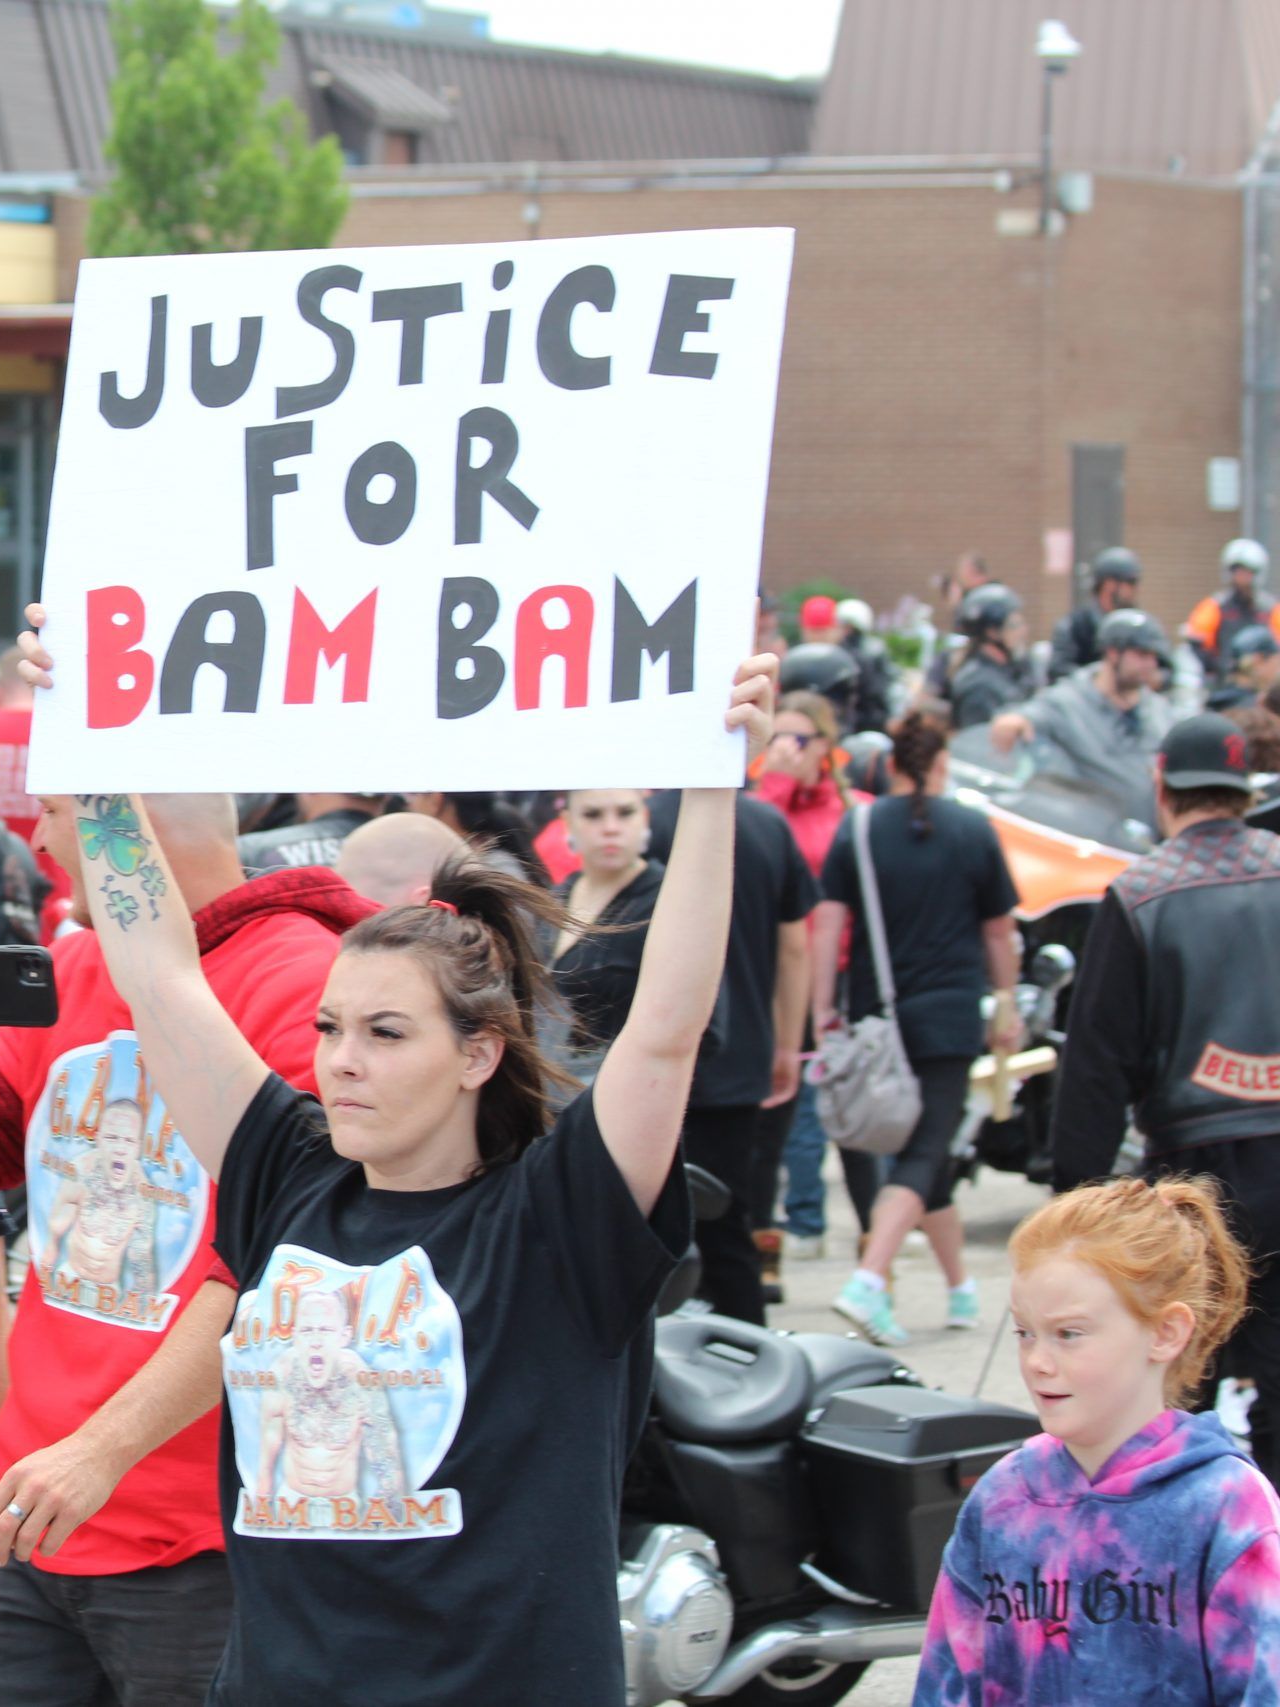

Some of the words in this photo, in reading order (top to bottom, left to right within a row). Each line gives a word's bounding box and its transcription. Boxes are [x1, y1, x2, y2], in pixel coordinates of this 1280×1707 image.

[245, 406, 540, 571] FOR
[86, 585, 380, 729] BAM
[437, 573, 698, 719] BAM
[330, 1495, 449, 1528] BAM
[983, 1564, 1070, 1638] Baby
[1081, 1567, 1178, 1628] Girl
